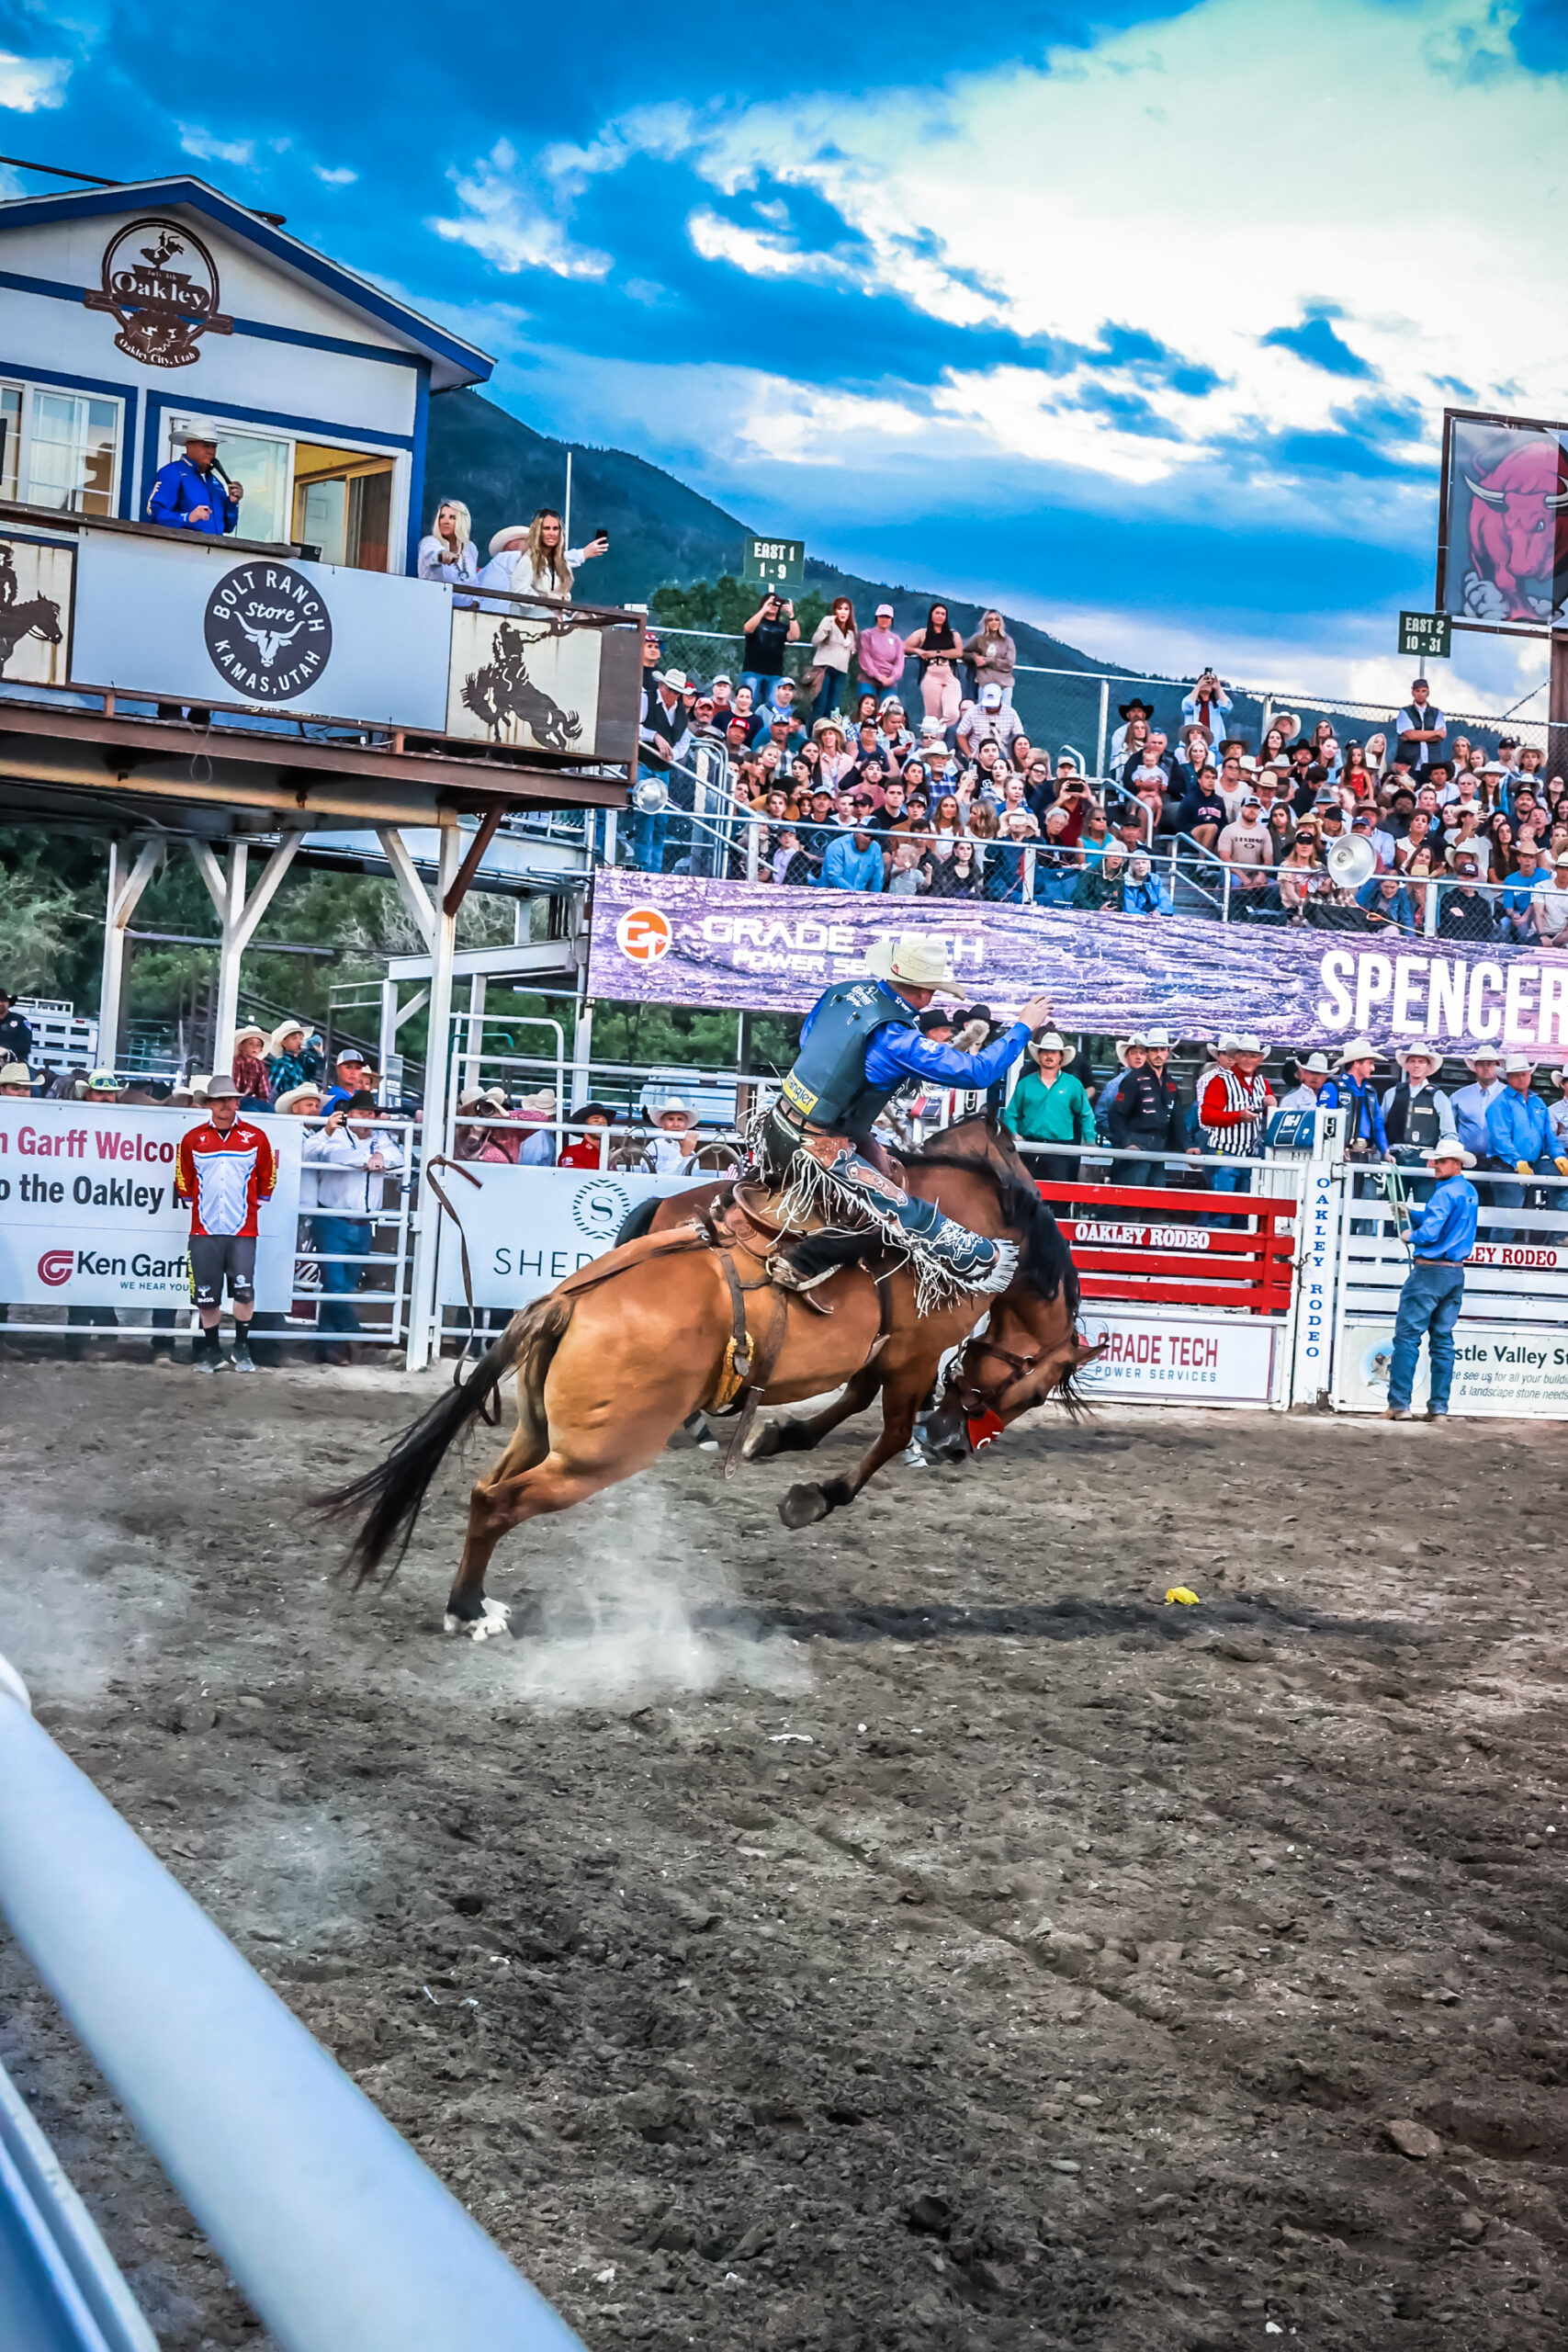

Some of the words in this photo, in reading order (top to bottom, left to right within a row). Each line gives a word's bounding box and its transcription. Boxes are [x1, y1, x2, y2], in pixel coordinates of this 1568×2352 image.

[114, 273, 206, 311] Oakley
[118, 338, 148, 362] Oakley
[174, 352, 197, 364] Utah
[753, 541, 786, 560] EAST
[789, 546, 795, 561] 1
[760, 561, 766, 578] 1
[777, 563, 787, 580] 9
[212, 571, 256, 620] BOLT
[265, 569, 326, 632] RANCH
[1404, 616, 1435, 634] EAST
[1436, 619, 1445, 635] 2
[1405, 635, 1419, 650] 10
[1428, 637, 1441, 652] 31
[277, 650, 321, 692] UTAH
[702, 915, 856, 955] GRADE
[732, 950, 826, 973] POWER
[1317, 949, 1568, 1046] SPENCER
[17, 1125, 88, 1159] Garff
[95, 1130, 181, 1164] Welco
[18, 1172, 64, 1204] the
[73, 1175, 165, 1215] Oakley
[1313, 1177, 1332, 1268] OAKLEY
[1075, 1223, 1147, 1246] OAKLEY
[1148, 1227, 1211, 1250] RODEO
[76, 1250, 127, 1276] Ken
[1501, 1247, 1558, 1267] RODEO
[119, 1281, 136, 1290] WE
[139, 1282, 166, 1291] HEAR
[169, 1283, 189, 1292] YOU
[1305, 1283, 1324, 1358] RODEO
[1097, 1331, 1162, 1364] GRADE
[1168, 1336, 1219, 1368] TECH
[1493, 1345, 1549, 1369] Valley
[1095, 1365, 1142, 1378] POWER
[1149, 1369, 1218, 1383] SERVICES
[1462, 1371, 1480, 1381] see
[1495, 1371, 1507, 1382] for
[1508, 1372, 1521, 1383] all
[1521, 1374, 1542, 1385] your
[1460, 1385, 1467, 1396] &
[1469, 1385, 1515, 1399] landscape
[1516, 1388, 1541, 1399] stone
